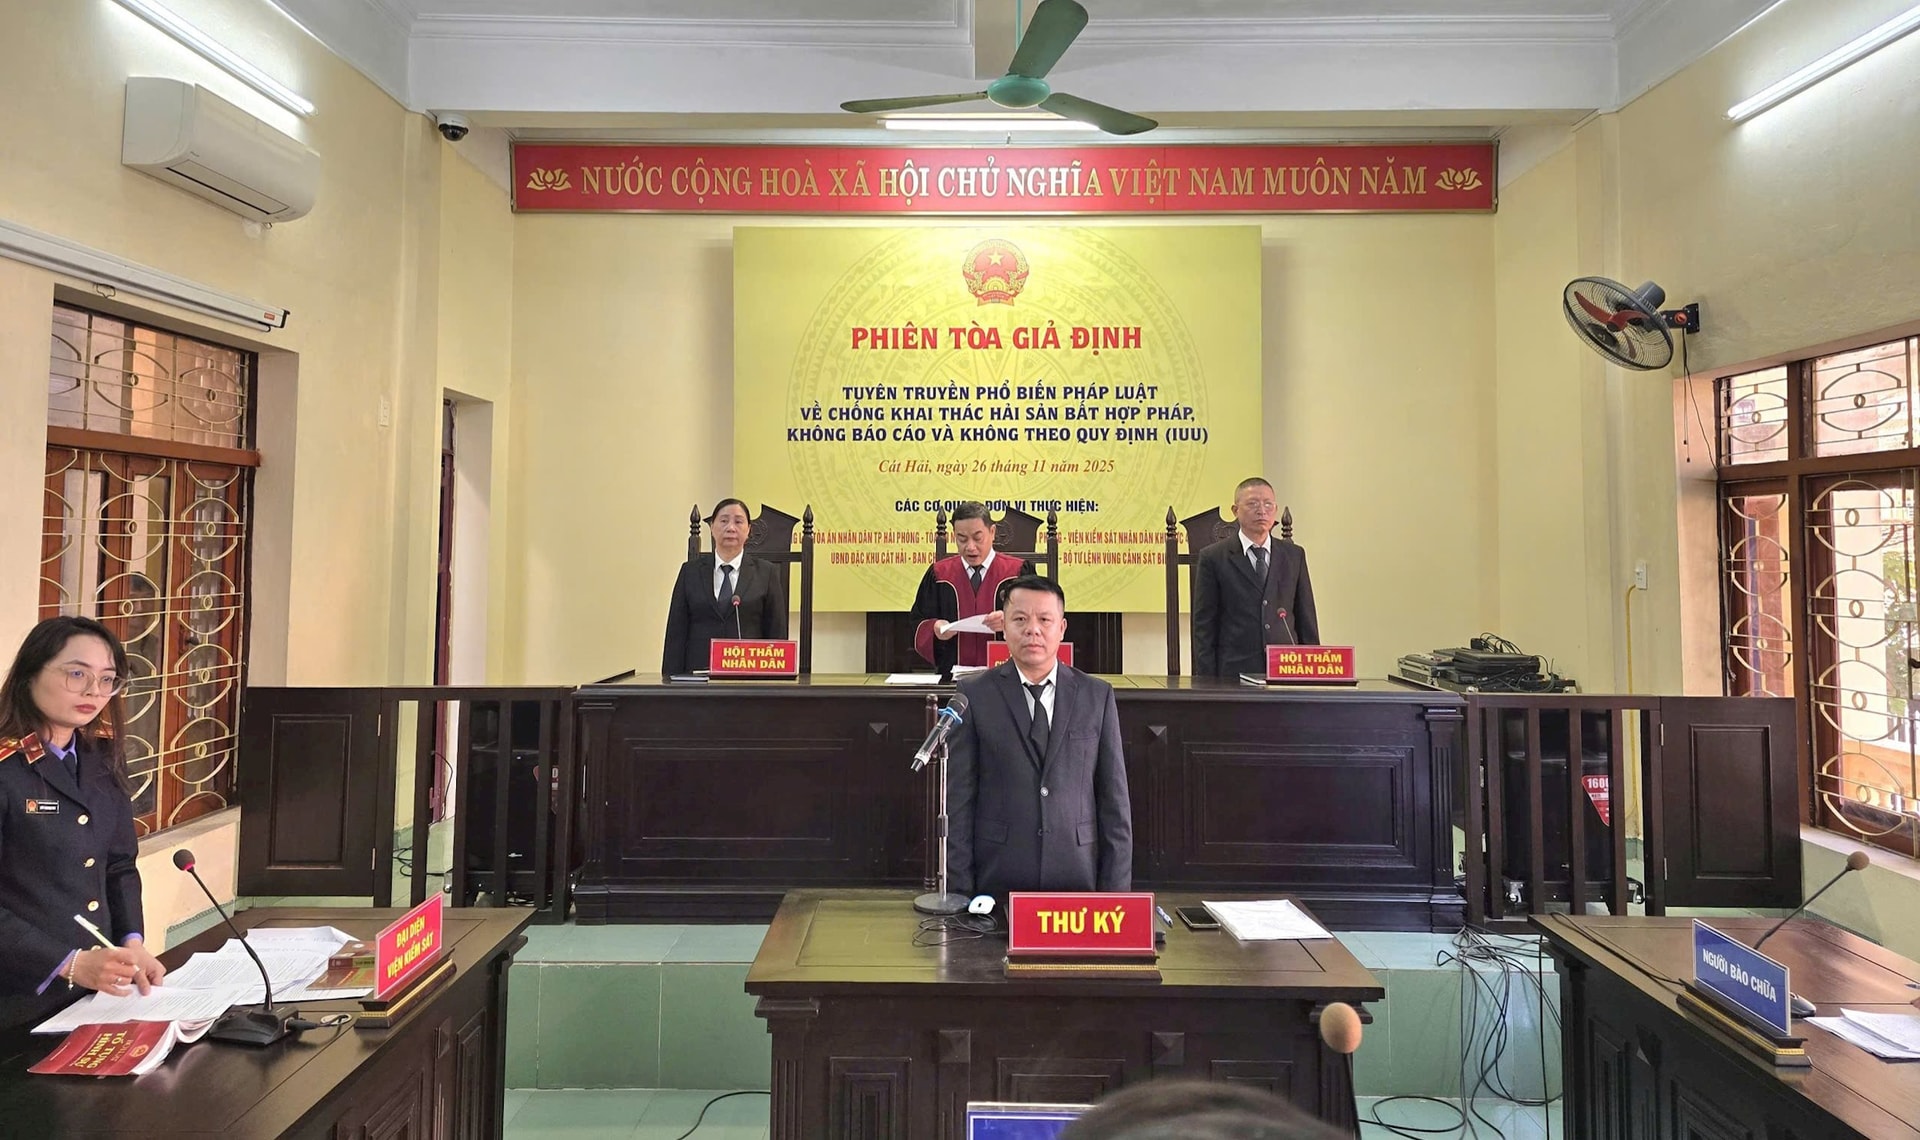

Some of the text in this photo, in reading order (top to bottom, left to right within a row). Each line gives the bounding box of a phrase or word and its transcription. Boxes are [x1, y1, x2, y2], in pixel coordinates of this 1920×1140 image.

[581, 156, 1427, 206] NƯỚC CỘNG HOÀ XÃ HỘI CHỦ NGHĨA VIỆT NAM MUÔN NĂM
[852, 320, 1142, 356] PHIÊN TÒA GIẢ ĐỊNH
[842, 378, 1158, 404] TUYÊN TRUYỀN PHỔ BIẾN PHÁP LUẬT
[800, 398, 1196, 425] VỀ CHỐNG KHAI THÁC HẢI SẢN BẤT HỢP PHÁP,
[787, 422, 1209, 446] KHÔNG BÁO CÁO VÀ KHÔNG THEO QUY ĐỊNH (IUU)
[936, 461, 968, 477] ngày
[972, 460, 988, 474] 26
[991, 459, 1030, 477] tháng
[1033, 460, 1047, 474] 11
[1050, 461, 1081, 474] năm
[1085, 460, 1115, 474] 2025
[895, 498, 920, 512] CÁC
[1065, 498, 1099, 515] HIỆN:
[838, 530, 857, 544] NHÂN
[858, 530, 873, 544] DÂN
[874, 531, 882, 544] TP
[883, 528, 896, 544] HẢI
[897, 529, 920, 544] PHÒNG
[1067, 529, 1084, 546] VIỆN
[1085, 527, 1103, 544] KIỂM
[1104, 529, 1117, 544] SÁT
[1119, 529, 1138, 544] NHÂN
[1139, 529, 1154, 544] DÂN
[831, 552, 850, 564] UBND
[851, 550, 865, 567] ĐẶC
[866, 552, 880, 564] KHU
[881, 550, 894, 564] CÁT
[895, 548, 907, 564] HẢI
[912, 552, 927, 564] BAN
[1142, 550, 1156, 564] SÁT
[723, 644, 785, 658] HỘI THẨM
[1280, 650, 1342, 664] HỘI THẨM
[722, 658, 786, 669] NHÂN DÂN
[1279, 664, 1344, 675] NHÂN DÂN
[396, 915, 426, 948] ĐẠI DIỆN
[1037, 905, 1126, 934] THƯ KÝ
[387, 931, 434, 979] VIỆN KIỂM SÁT
[1702, 948, 1728, 975] NGƯỜI
[1750, 976, 1777, 1003] CHỮA
